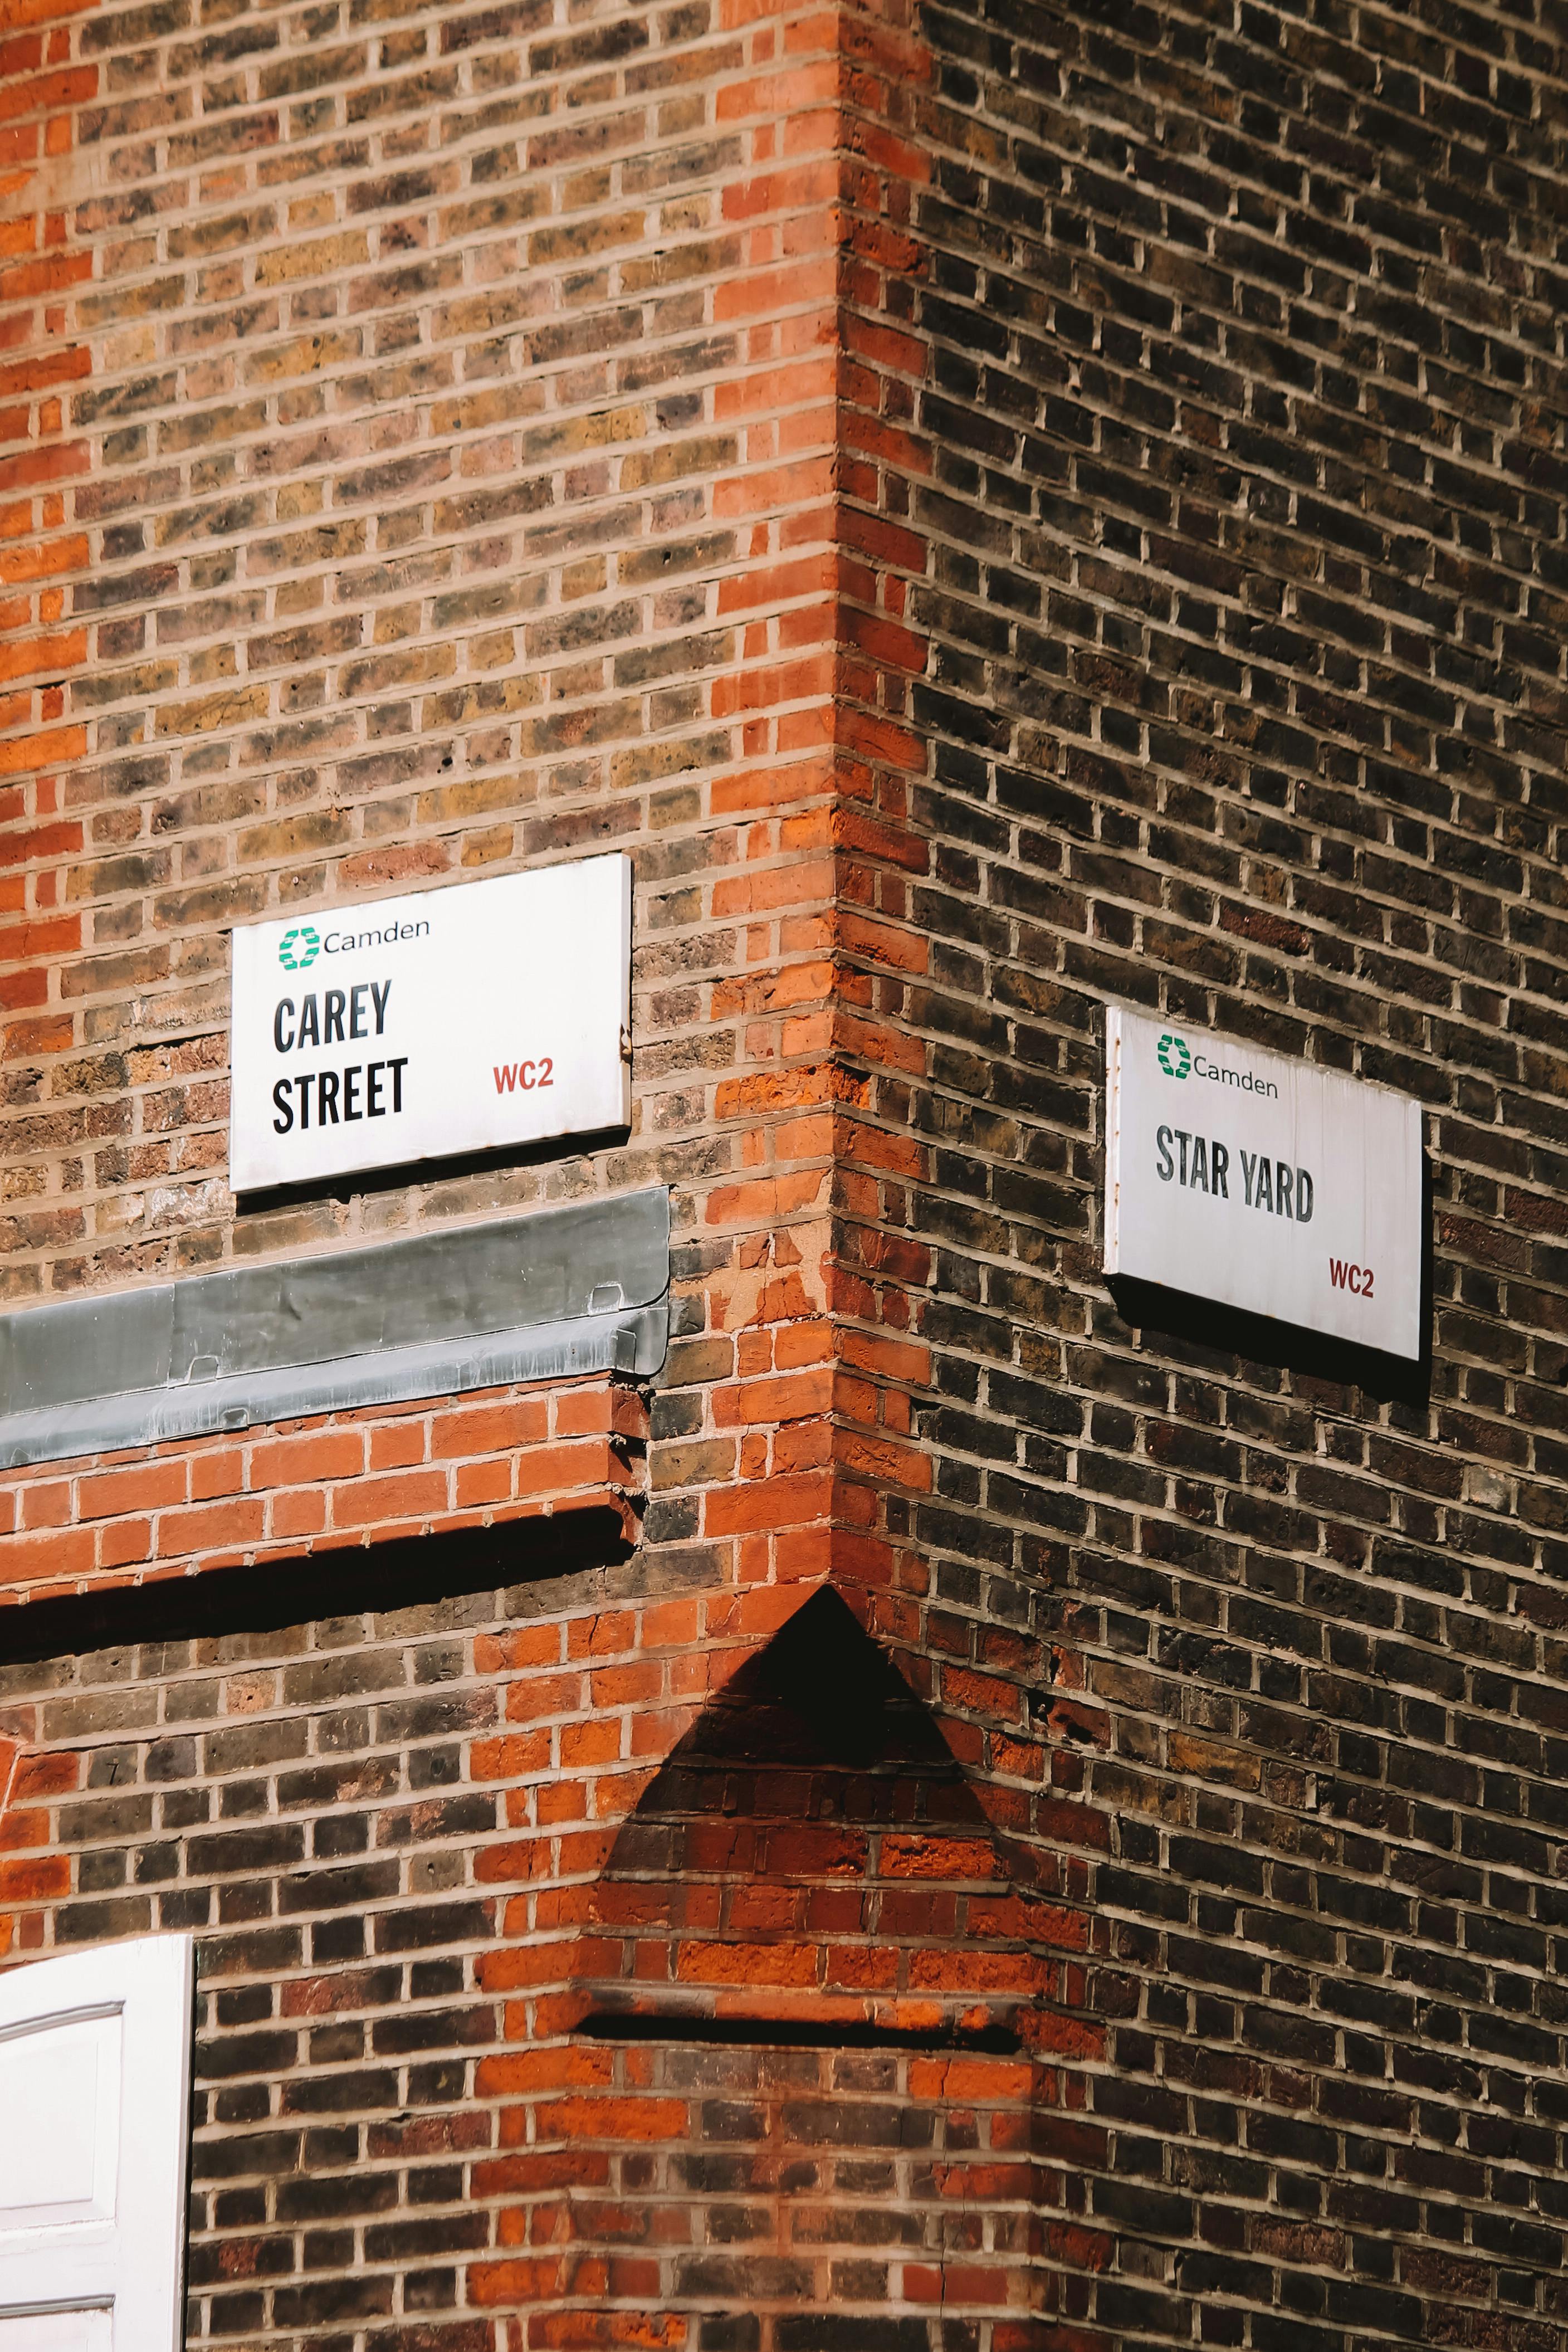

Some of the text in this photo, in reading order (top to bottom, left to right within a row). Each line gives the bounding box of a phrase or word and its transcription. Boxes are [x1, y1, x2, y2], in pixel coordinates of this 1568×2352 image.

[324, 920, 431, 954] Camden
[273, 980, 392, 1053] CAREY
[272, 1057, 408, 1134] STREET
[493, 1058, 554, 1094] WC2
[1194, 1055, 1278, 1100] Camden
[1156, 1125, 1314, 1223] STAR YARD
[1329, 1257, 1375, 1299] WC2
